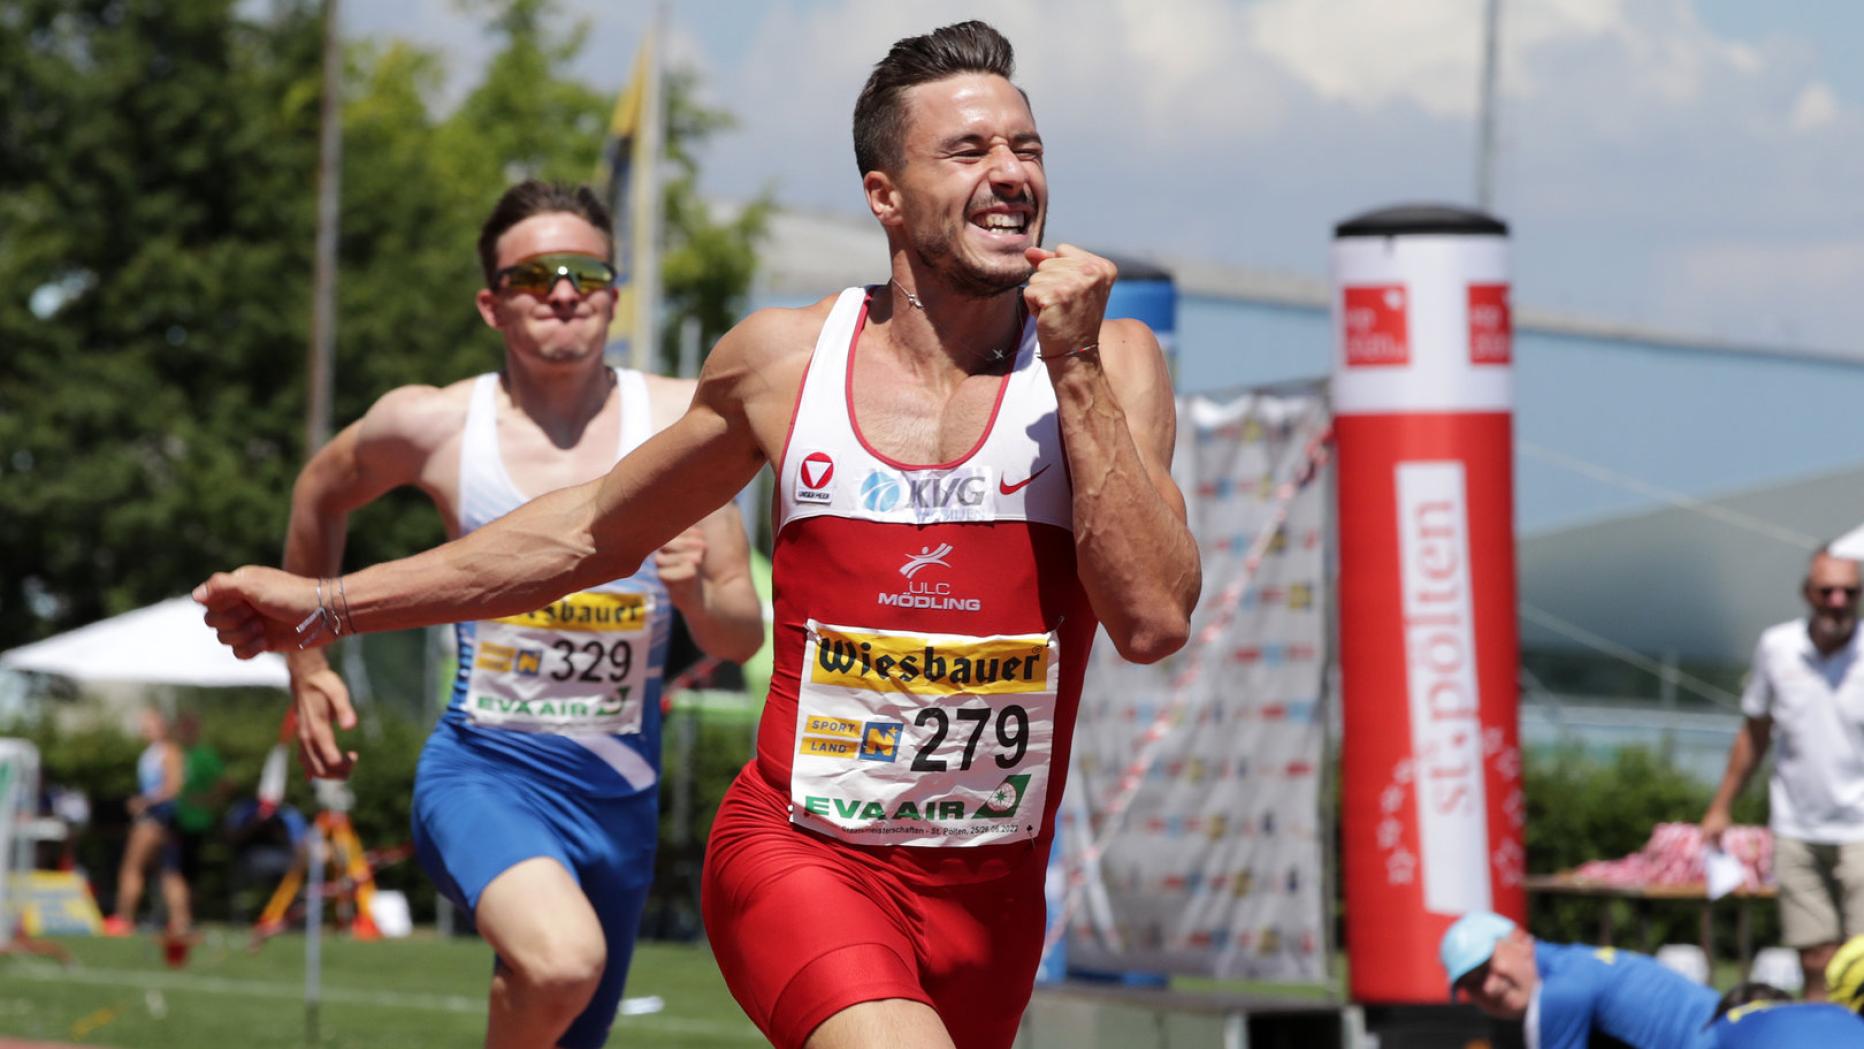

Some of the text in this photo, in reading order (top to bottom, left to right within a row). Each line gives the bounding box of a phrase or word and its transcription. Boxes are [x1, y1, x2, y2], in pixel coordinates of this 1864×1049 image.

[904, 476, 986, 508] KVG
[909, 581, 950, 595] ULC
[527, 601, 638, 623] sbauer
[878, 592, 981, 611] MÖDLING
[551, 639, 632, 683] 329
[818, 637, 1041, 683] Wiesbauer
[811, 720, 856, 733] SPORT
[811, 741, 848, 754] LAND
[910, 704, 1030, 772] 279
